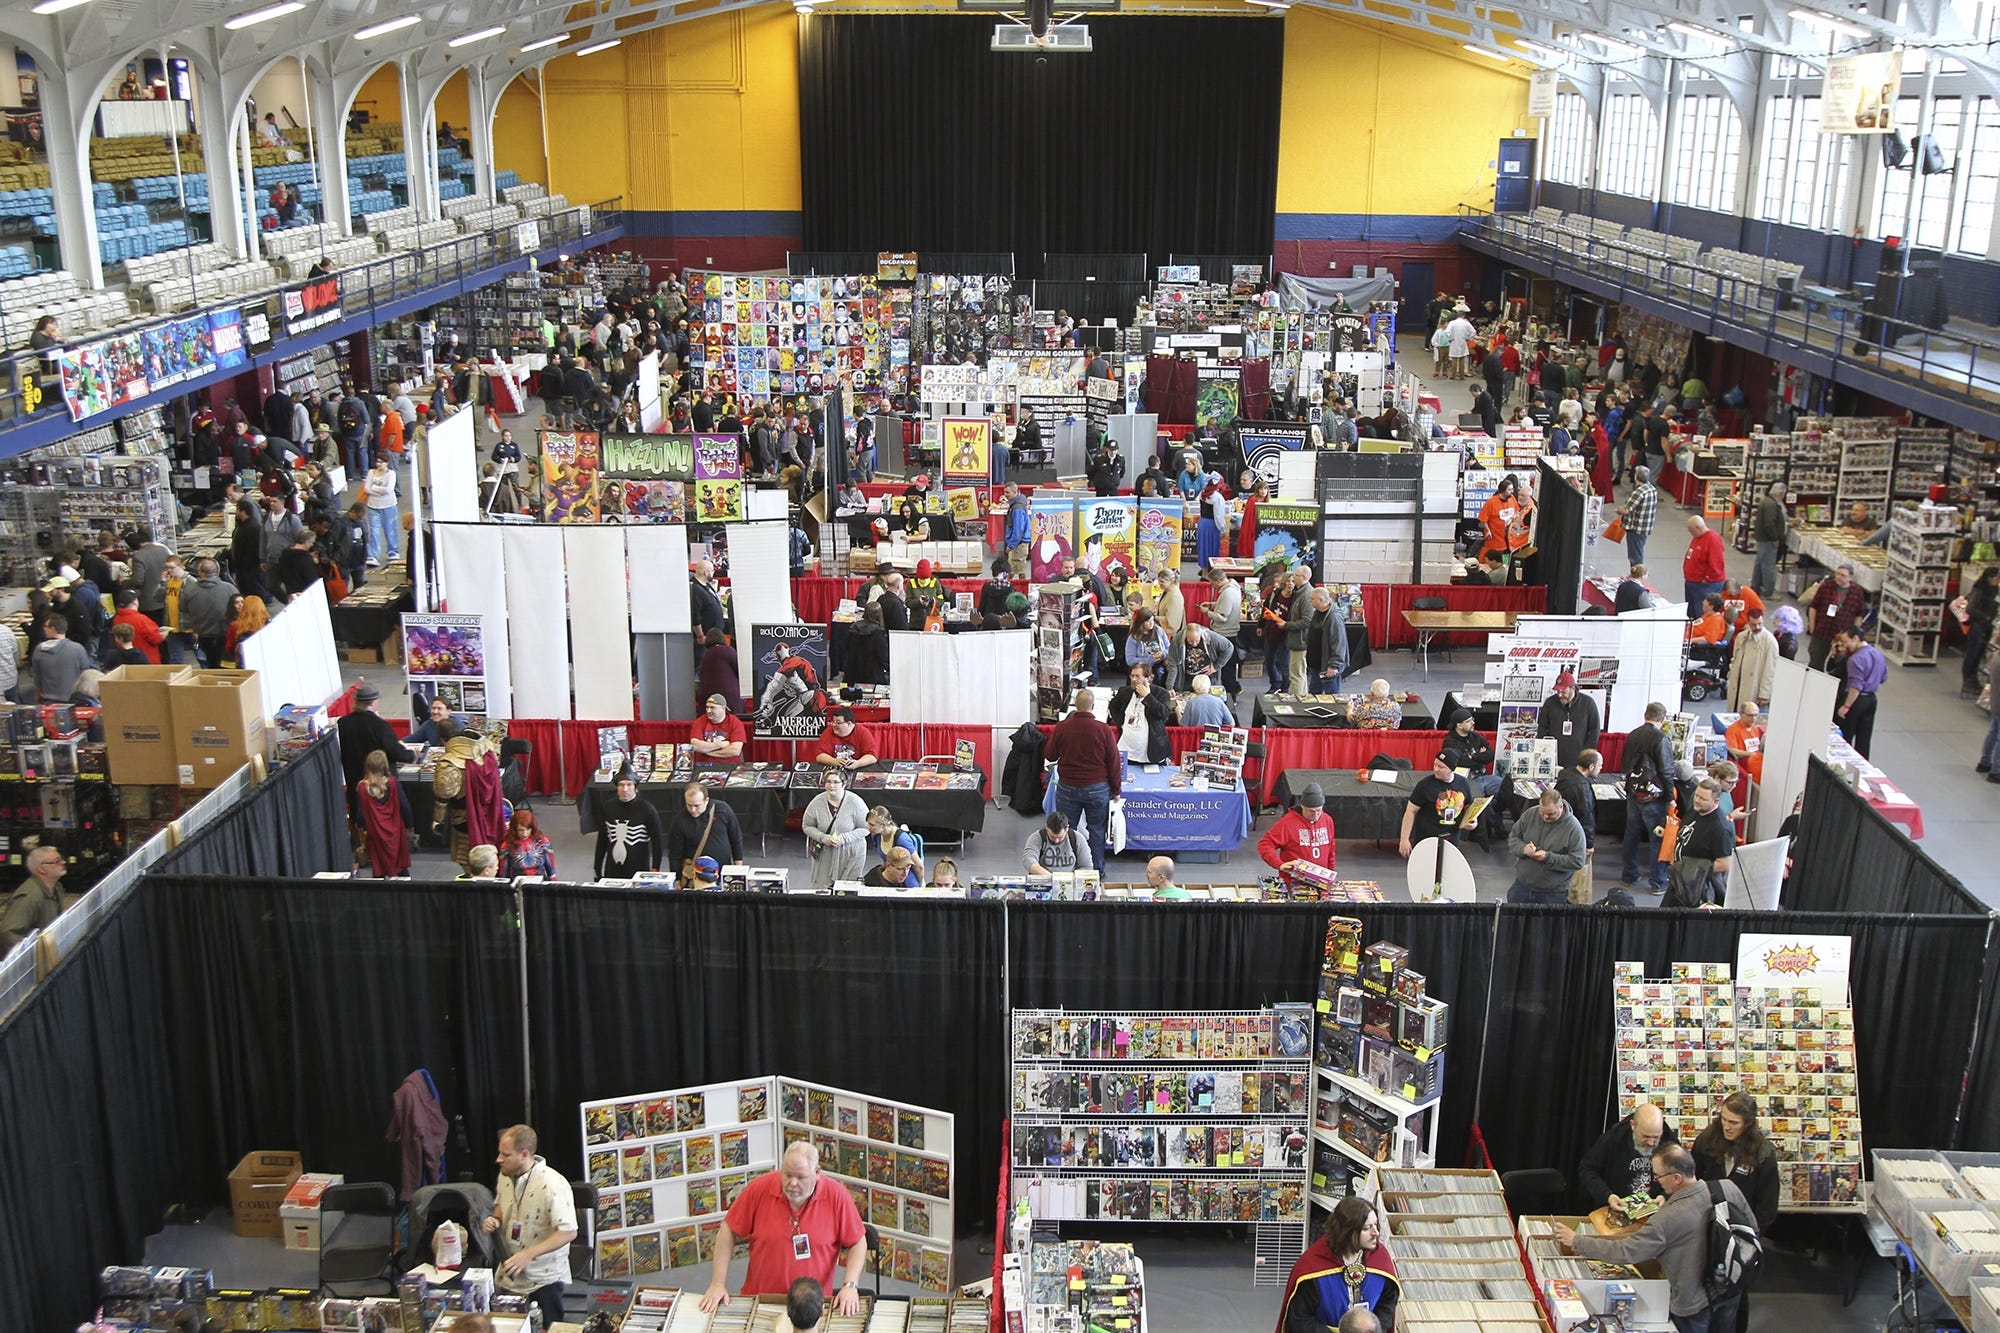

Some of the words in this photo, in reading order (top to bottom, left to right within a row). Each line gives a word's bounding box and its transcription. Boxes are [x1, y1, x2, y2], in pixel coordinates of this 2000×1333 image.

[248, 313, 268, 329] STAR
[213, 325, 242, 354] MARVEL
[249, 327, 270, 345] WARS
[1198, 369, 1220, 379] DARRYL
[1220, 370, 1240, 379] BANKS
[953, 424, 985, 441] WOW!
[1258, 428, 1307, 436] LAGRANGE
[607, 438, 689, 474] HAZZUM!
[1095, 507, 1123, 518] Thom
[1259, 509, 1278, 519] PAUL
[1279, 510, 1287, 519] D.
[1288, 510, 1317, 520] STORRIE
[1093, 515, 1125, 526] Zahler
[405, 616, 432, 625] MARC
[433, 616, 480, 625] SUMERAK!
[760, 628, 771, 636] RICK
[771, 626, 810, 638] LOZANO
[1508, 647, 1542, 657] AARON
[1541, 648, 1579, 658] ARCHER
[775, 716, 826, 727] AMERICAN
[781, 726, 819, 736] KNIGHT
[1164, 801, 1197, 812] Group,
[1200, 801, 1223, 810] LLC
[1127, 811, 1151, 819] Books
[1169, 812, 1209, 821] Magazines
[1043, 847, 1076, 867] Ohio
[1773, 961, 1809, 969] COMICS
[1363, 978, 1388, 995] WOLVERINE
[809, 1090, 830, 1103] FLASH
